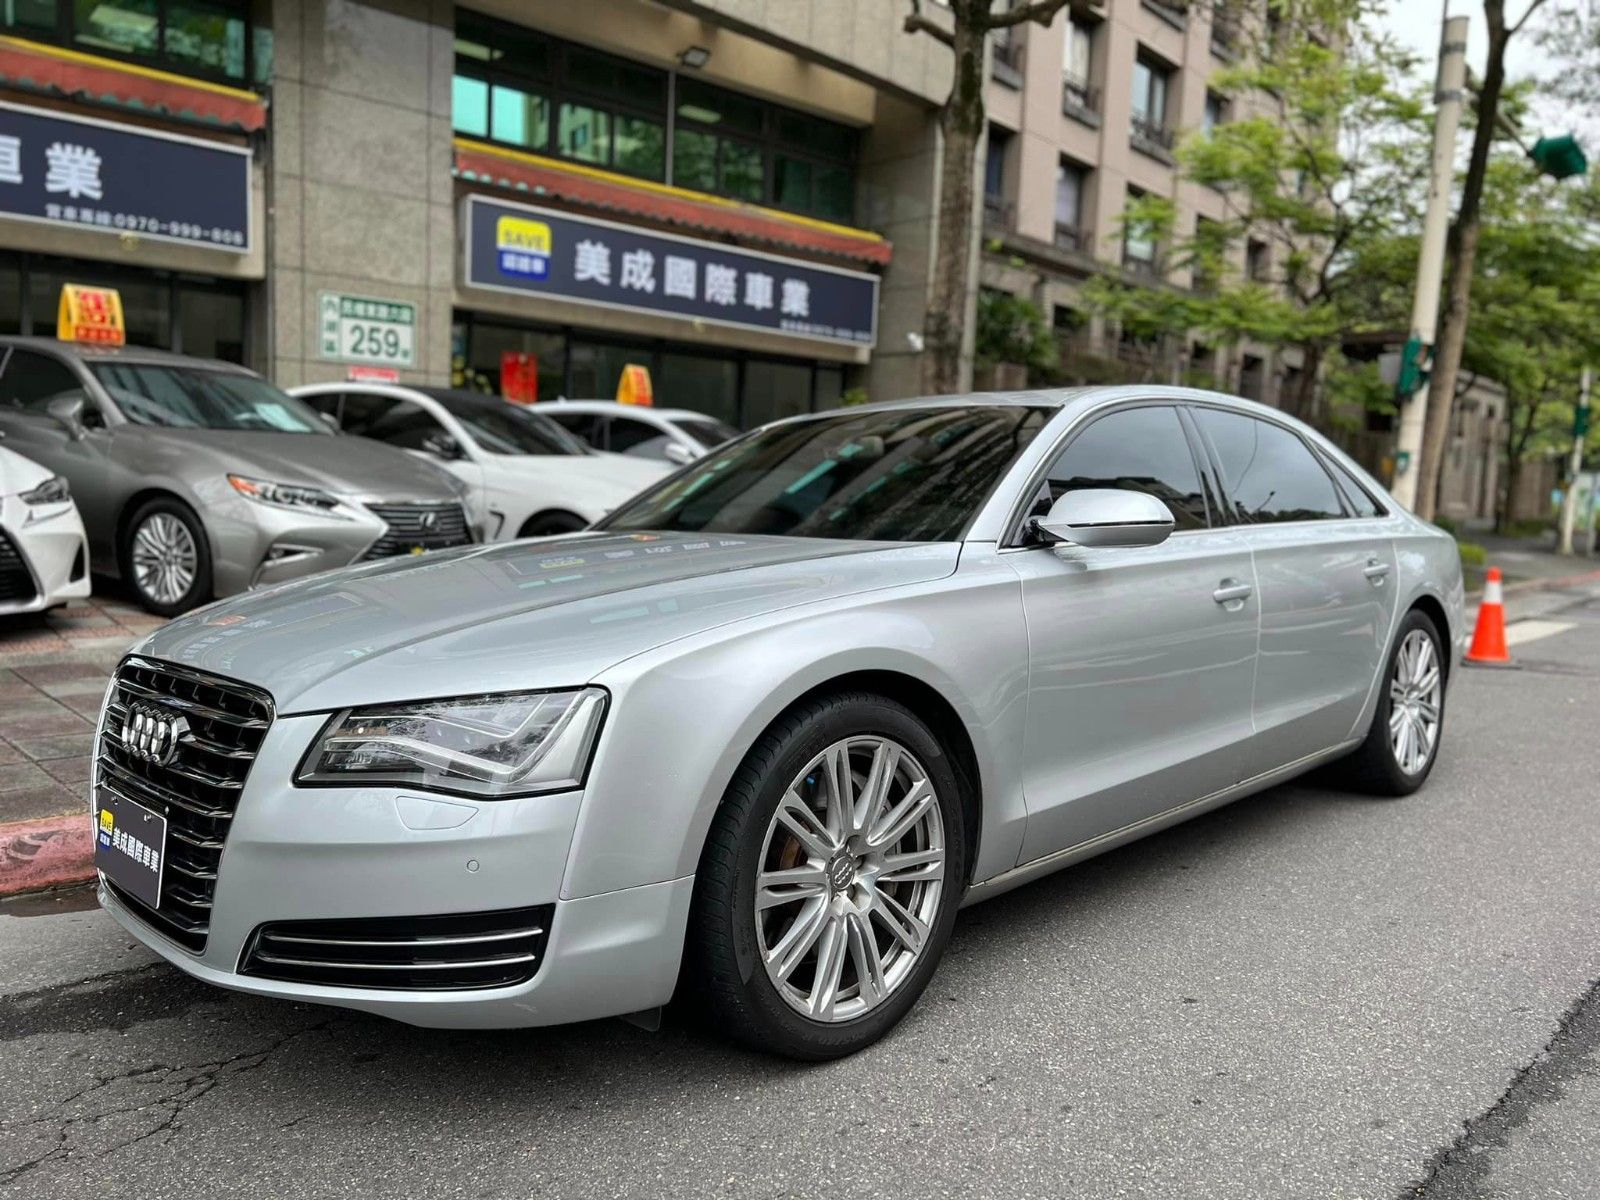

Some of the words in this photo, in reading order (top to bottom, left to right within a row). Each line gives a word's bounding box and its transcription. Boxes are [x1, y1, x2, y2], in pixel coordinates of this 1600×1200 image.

[574, 239, 811, 318] 美成國際車業
[112, 826, 160, 873] 美成國際車業
